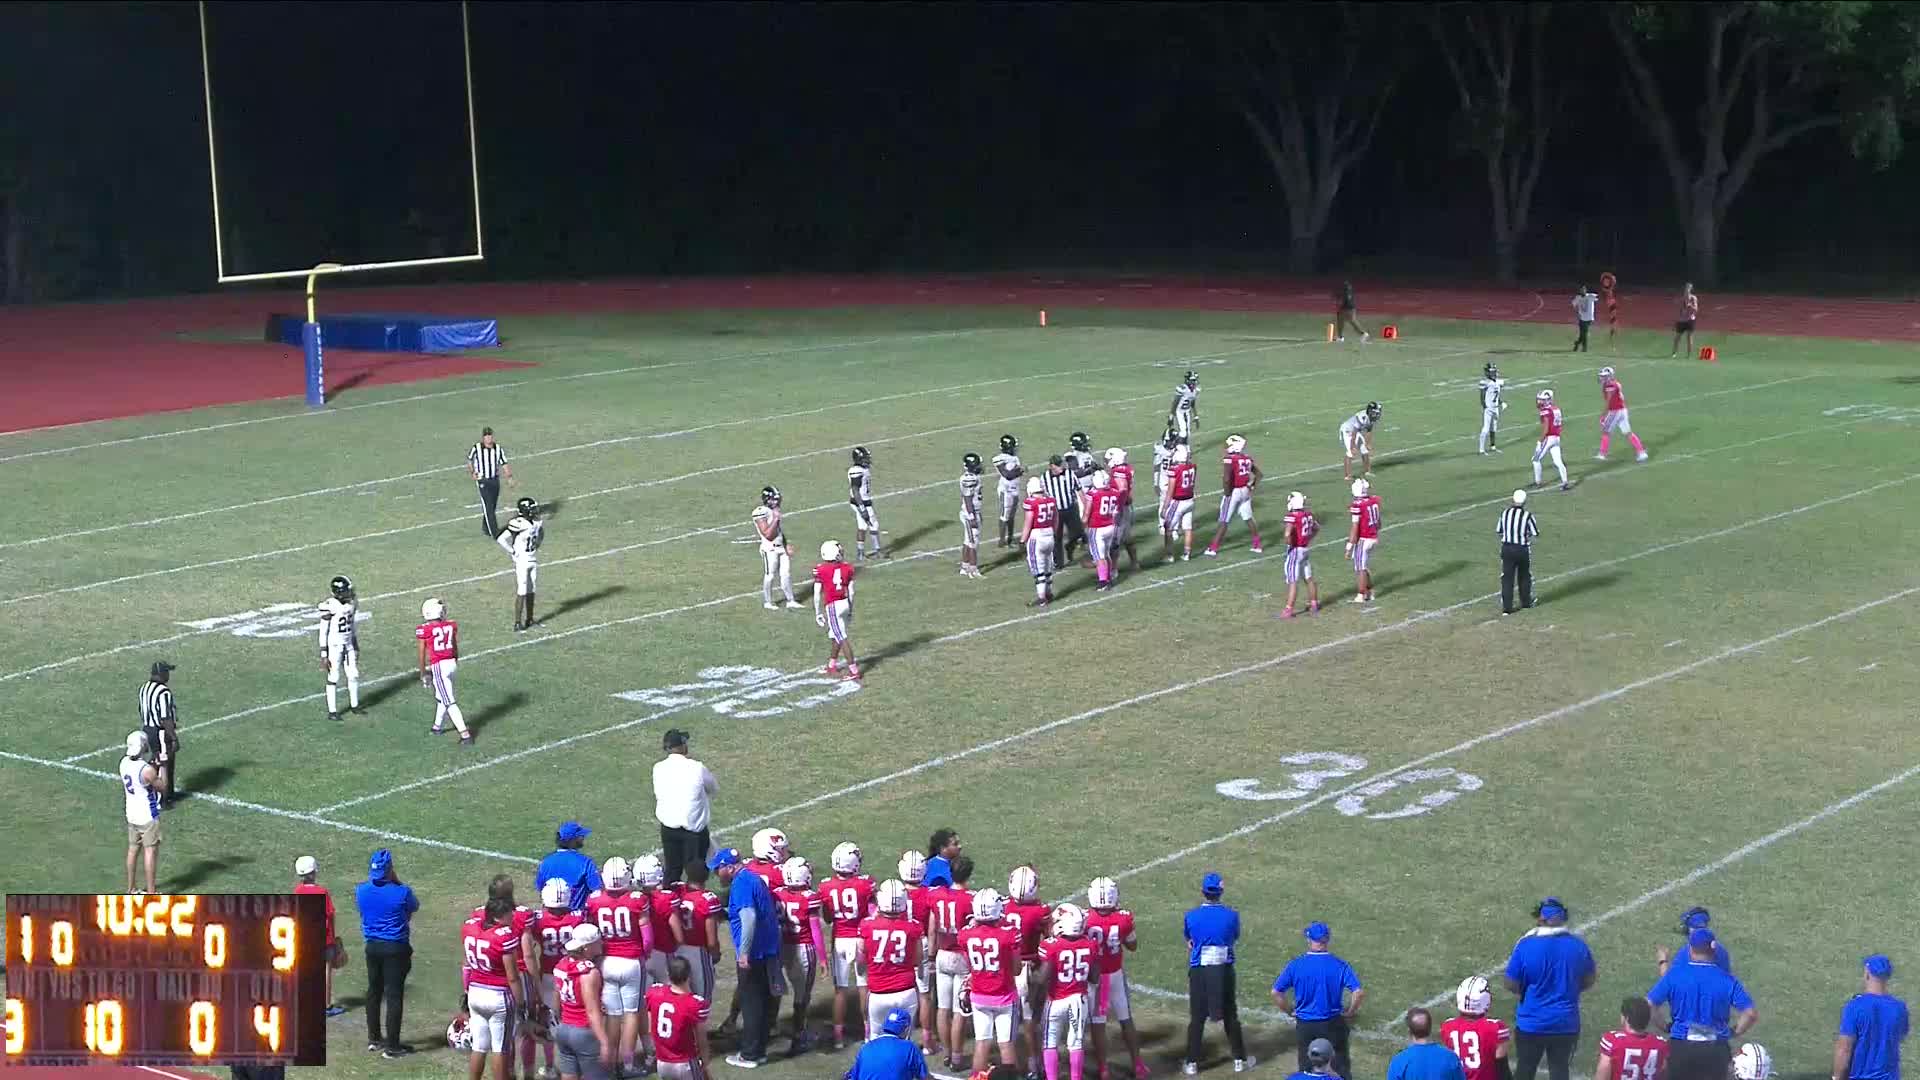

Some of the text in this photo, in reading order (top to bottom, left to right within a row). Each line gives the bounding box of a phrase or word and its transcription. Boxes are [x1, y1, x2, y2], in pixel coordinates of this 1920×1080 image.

[1366, 503, 1380, 526] 10
[832, 568, 843, 591] 4
[431, 625, 454, 652] 27
[1215, 751, 1485, 820] 30
[829, 888, 859, 919] 19
[936, 900, 958, 934] 11
[597, 907, 632, 939] 60
[464, 935, 493, 972] 65
[872, 929, 908, 964] 73
[966, 937, 1000, 973] 62
[1057, 947, 1090, 983] 35
[657, 1001, 675, 1039] 6
[1449, 1030, 1481, 1069] 13
[1621, 1048, 1659, 1080] 54
